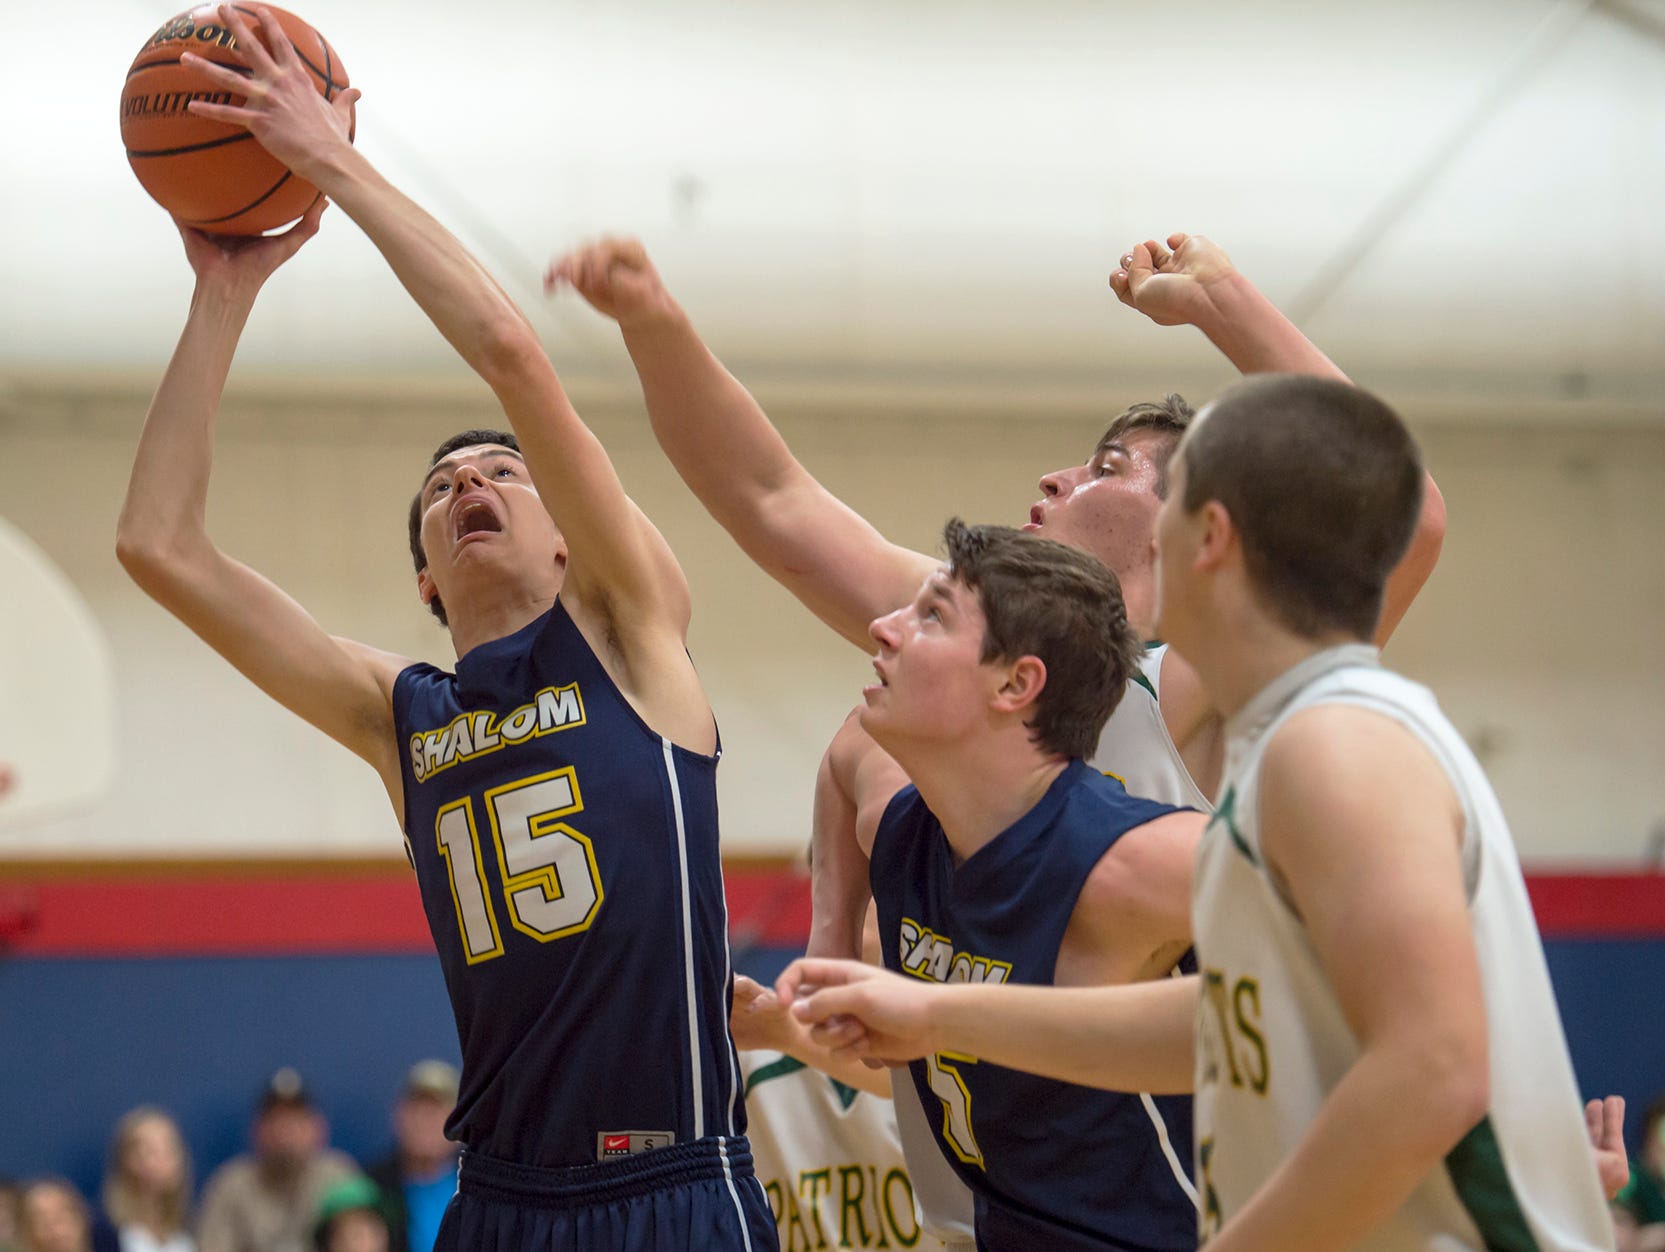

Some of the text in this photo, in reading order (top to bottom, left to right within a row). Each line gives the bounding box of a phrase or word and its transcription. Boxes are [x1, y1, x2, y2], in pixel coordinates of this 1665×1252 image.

[410, 682, 586, 784] SHALOM
[435, 765, 604, 966] 15
[899, 917, 1013, 984] SHAOM
[644, 1138, 654, 1151] S
[764, 1164, 922, 1252] PATRIO
